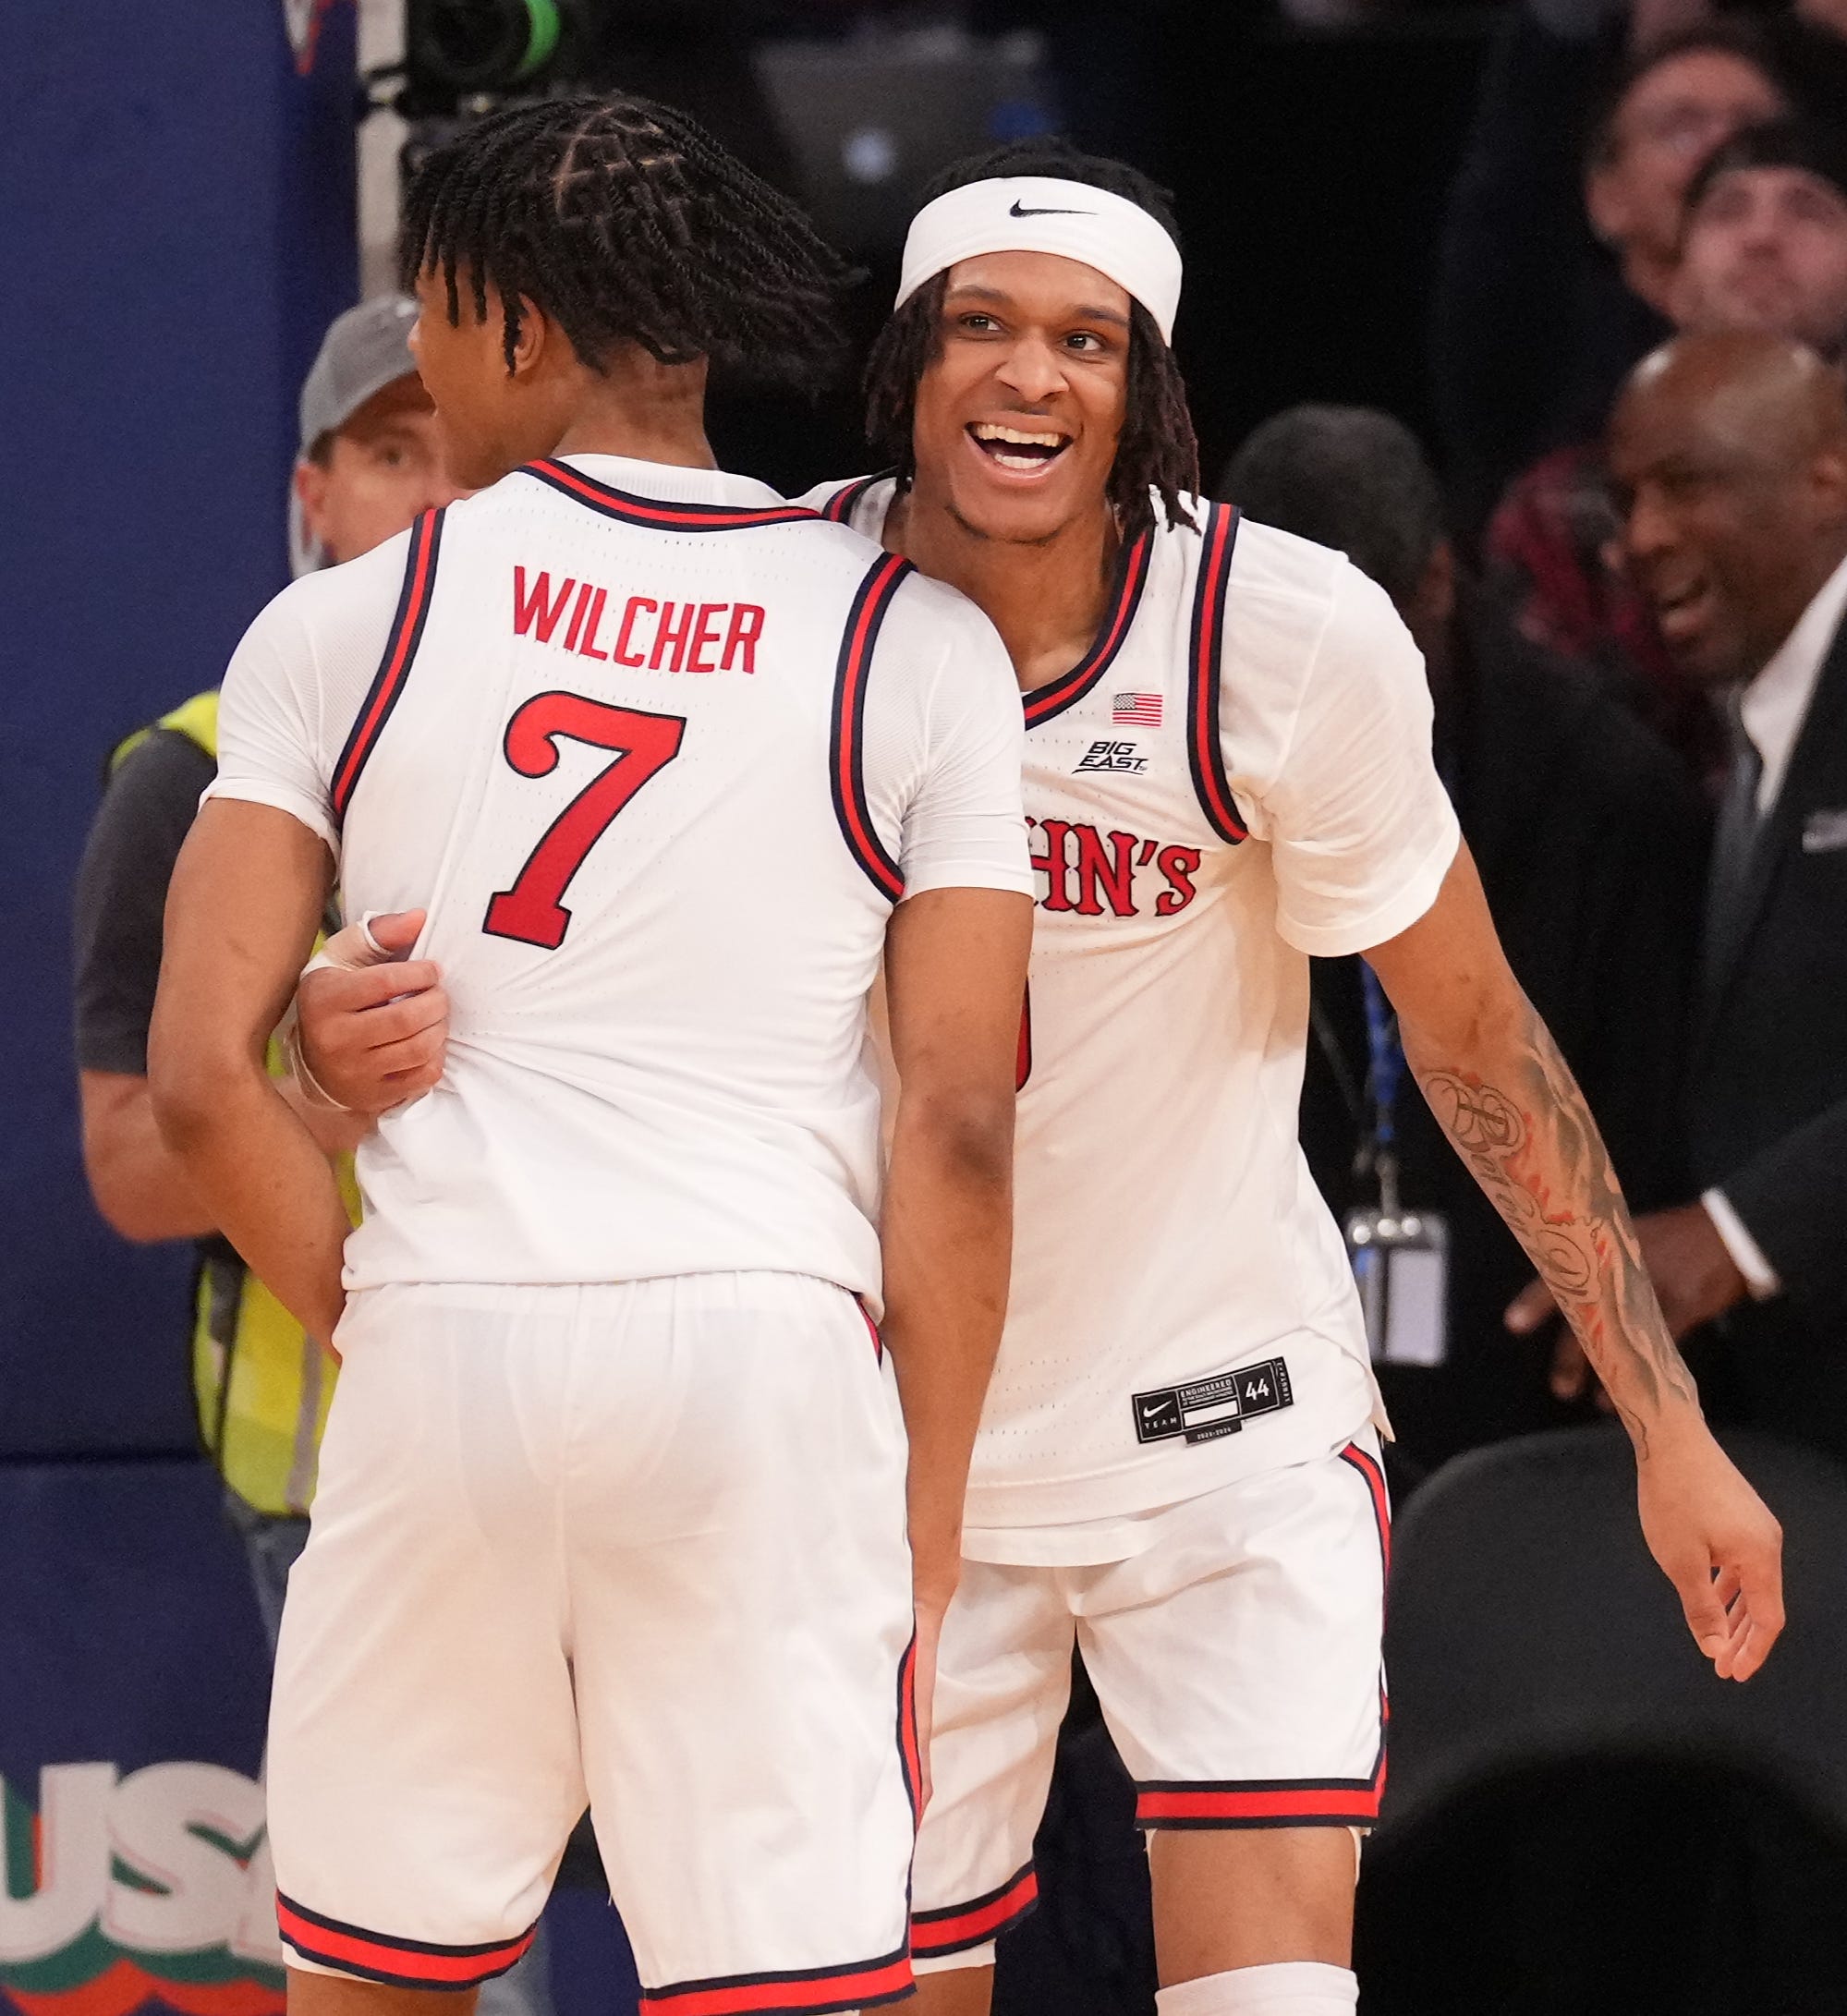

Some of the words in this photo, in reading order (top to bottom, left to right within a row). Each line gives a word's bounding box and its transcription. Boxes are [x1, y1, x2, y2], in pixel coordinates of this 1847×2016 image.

[514, 565, 765, 674] WILCHER
[1088, 741, 1136, 755] BIG
[1078, 755, 1148, 770] EAST
[482, 690, 687, 951] 7
[1180, 1378, 1232, 1398] ENGINEERED
[1246, 1378, 1270, 1401] 44
[1145, 1416, 1177, 1429] TEAM
